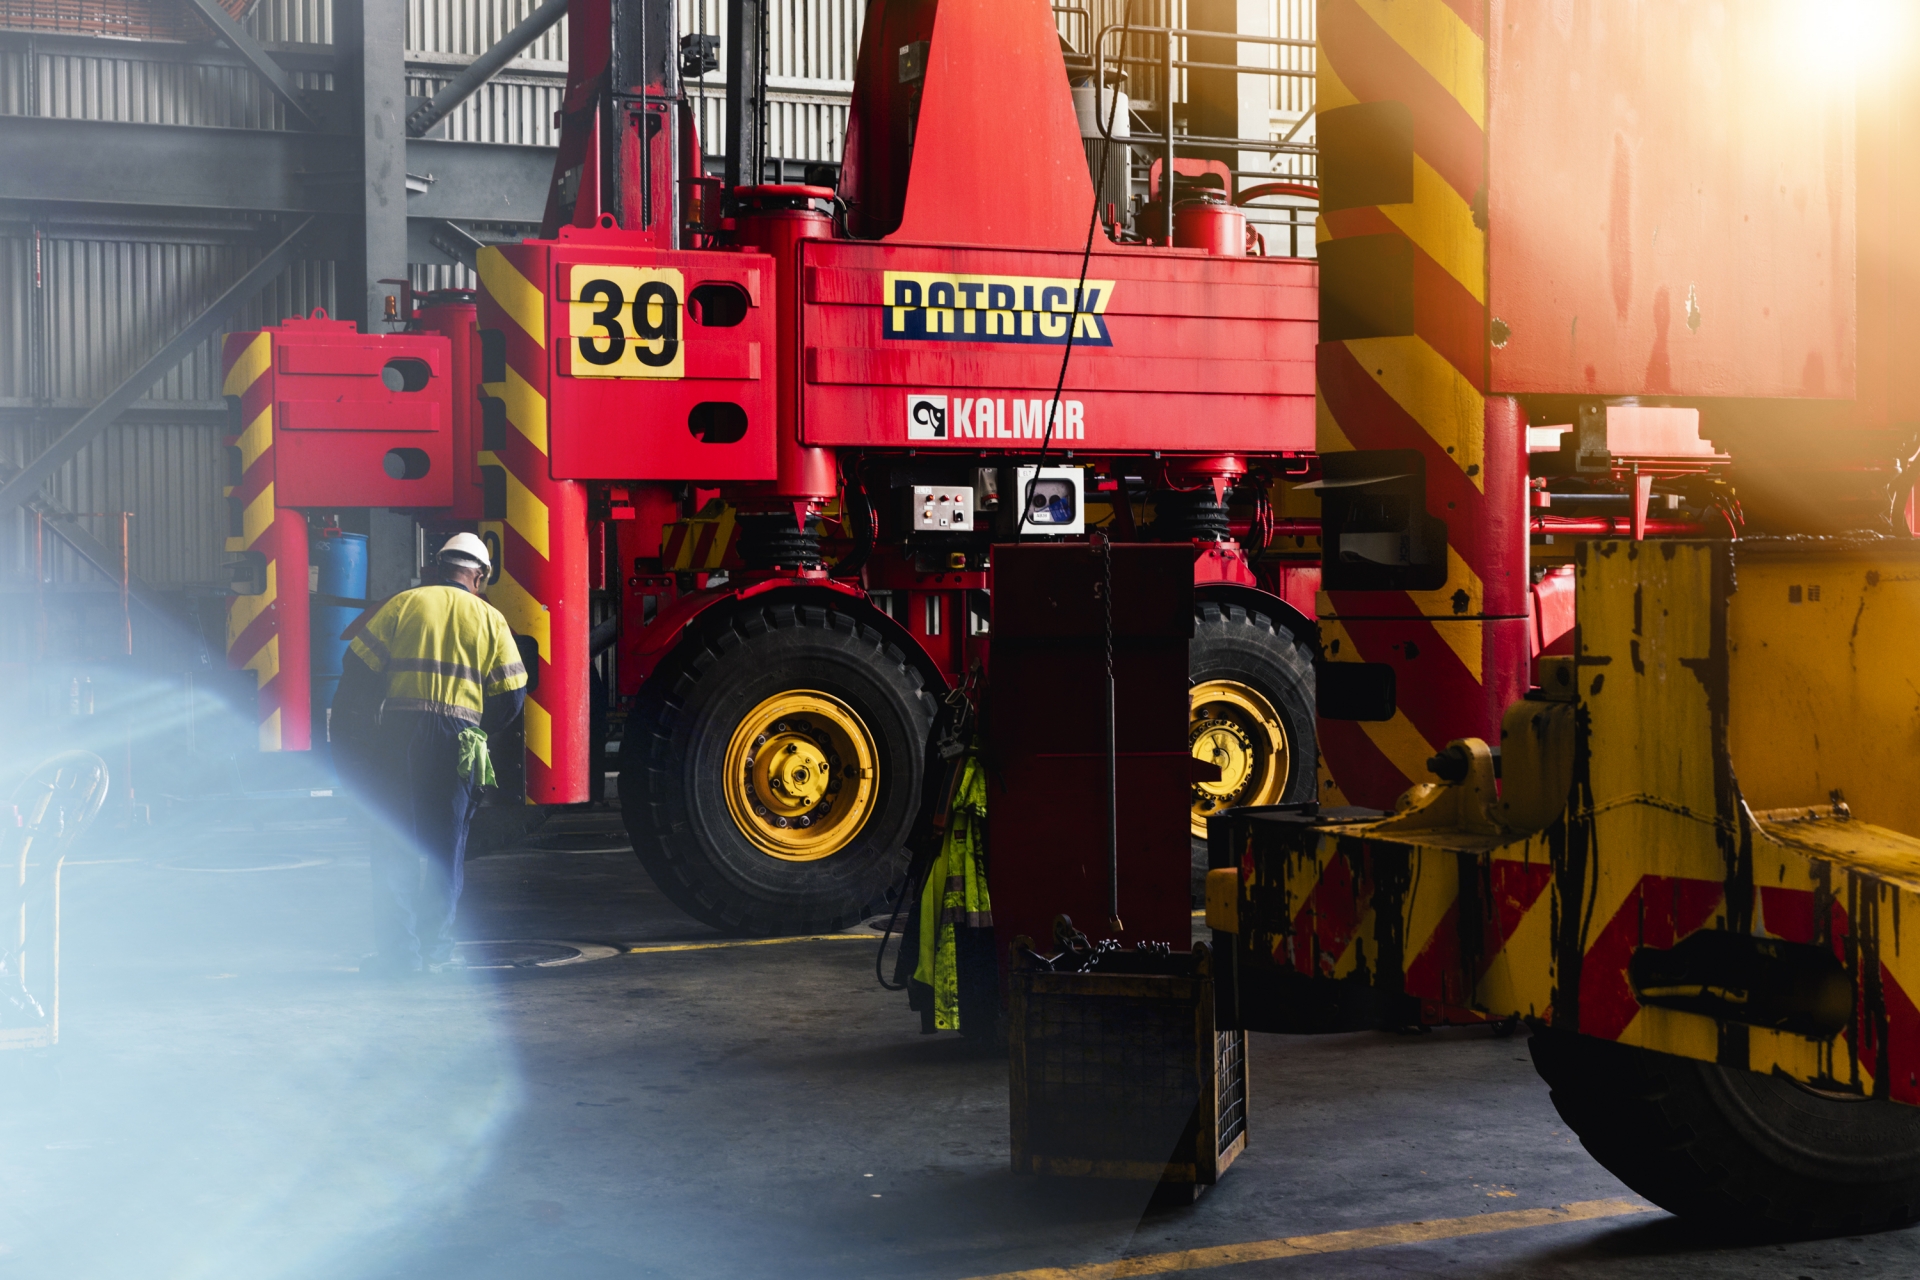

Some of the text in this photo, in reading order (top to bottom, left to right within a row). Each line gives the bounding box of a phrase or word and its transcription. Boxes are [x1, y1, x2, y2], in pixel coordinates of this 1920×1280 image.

[579, 279, 681, 367] 39
[892, 279, 1104, 338] PATRICK
[953, 397, 1085, 440] KALMAR
